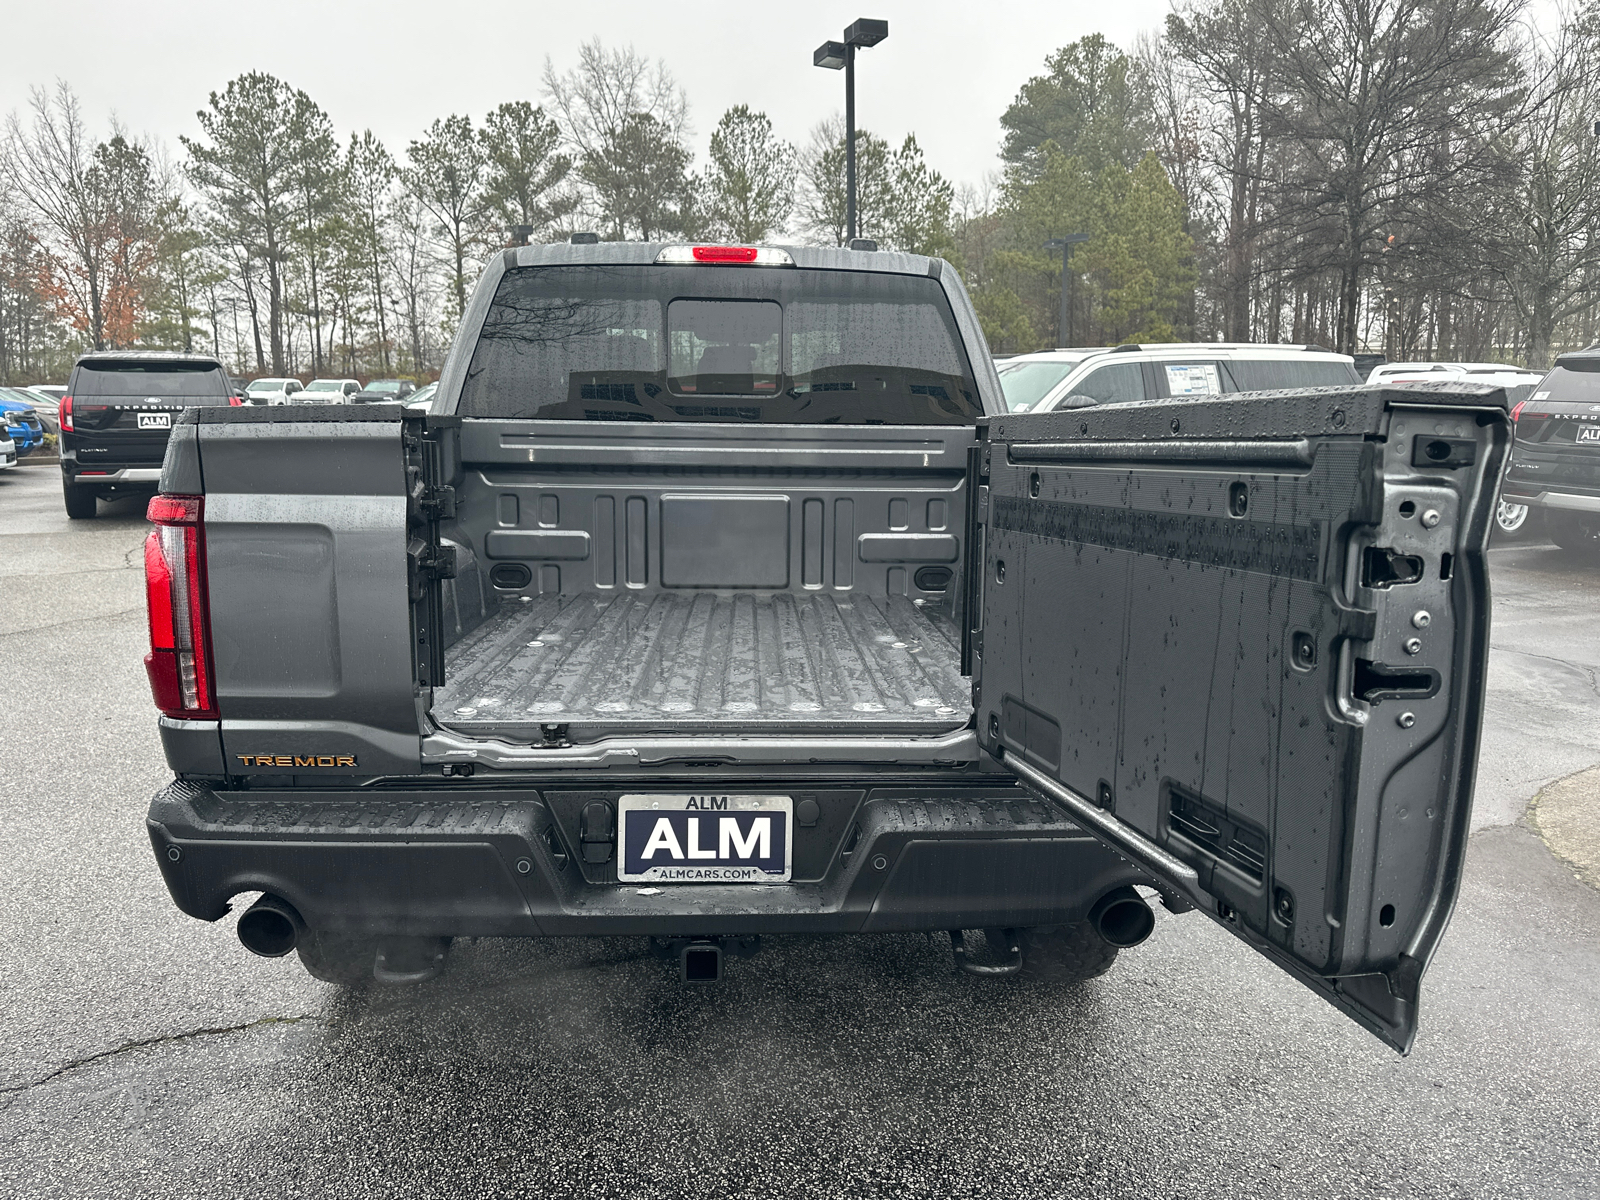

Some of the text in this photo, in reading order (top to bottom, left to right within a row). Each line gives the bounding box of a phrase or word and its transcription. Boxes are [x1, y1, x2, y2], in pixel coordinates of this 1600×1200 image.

[142, 416, 168, 426] ALM
[236, 754, 358, 767] TREMOR
[686, 796, 728, 810] ALM
[641, 817, 771, 859] ALM
[660, 869, 751, 879] ALMCARS.COM
